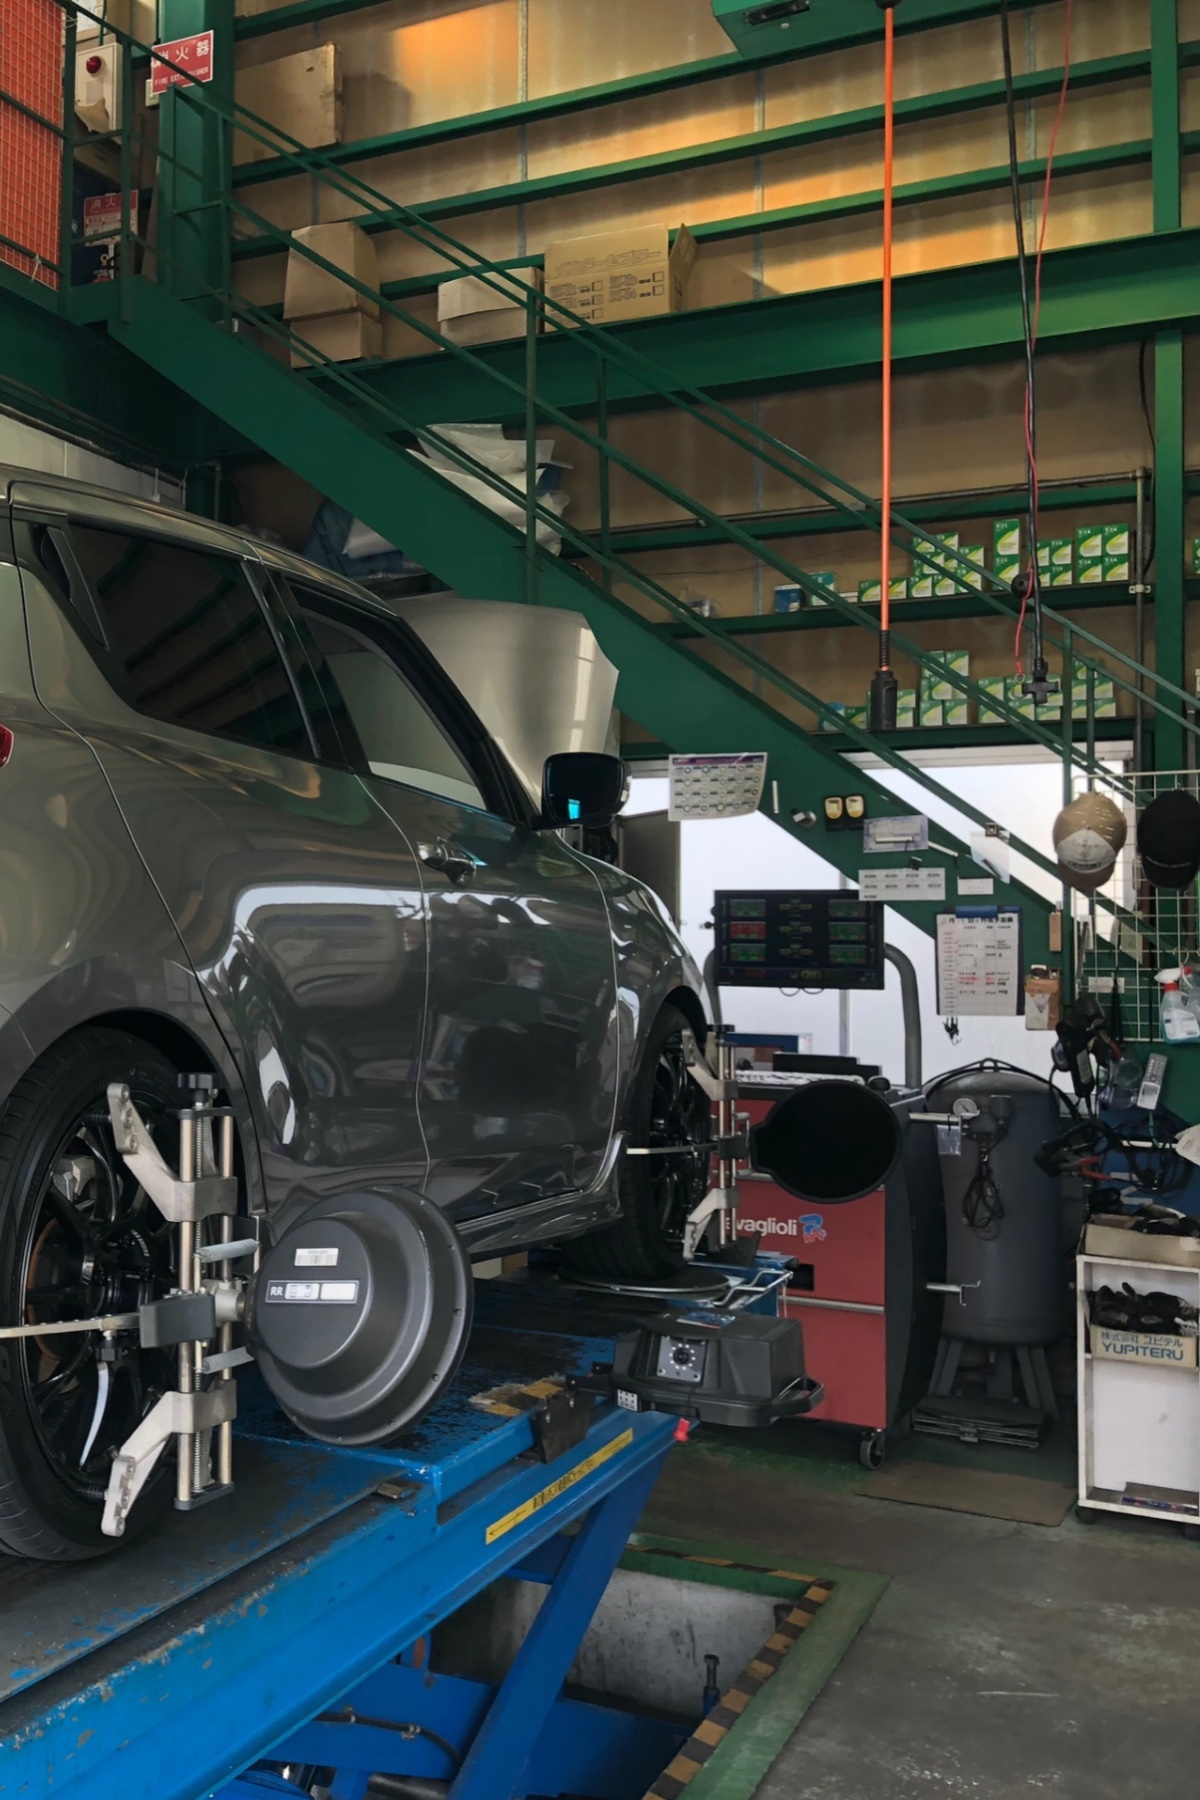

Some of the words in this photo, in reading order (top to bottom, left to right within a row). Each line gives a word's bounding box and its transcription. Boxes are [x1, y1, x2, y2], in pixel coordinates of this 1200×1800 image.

[155, 77, 169, 86] FIRE
[270, 1286, 284, 1297] RR
[1101, 1331, 1139, 1344] 株式会社
[1144, 1335, 1183, 1347] ユピテル
[1102, 1342, 1184, 1361] YUPITERU
